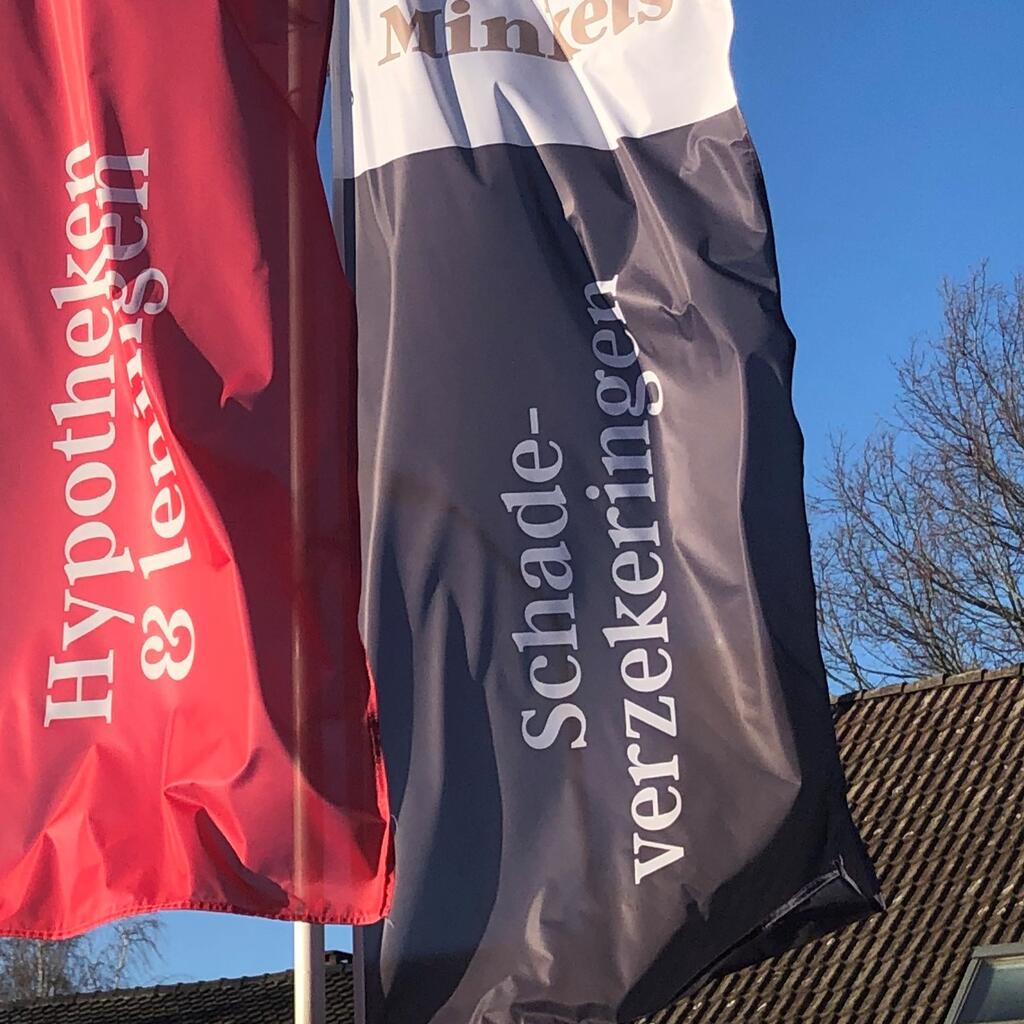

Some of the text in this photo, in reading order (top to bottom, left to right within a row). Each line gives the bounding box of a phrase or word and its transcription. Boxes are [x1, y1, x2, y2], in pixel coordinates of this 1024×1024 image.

[43, 140, 136, 728] Hypotheken
[140, 604, 196, 682] &
[499, 407, 588, 751] Schade-
[583, 274, 686, 886] verzekeringen
